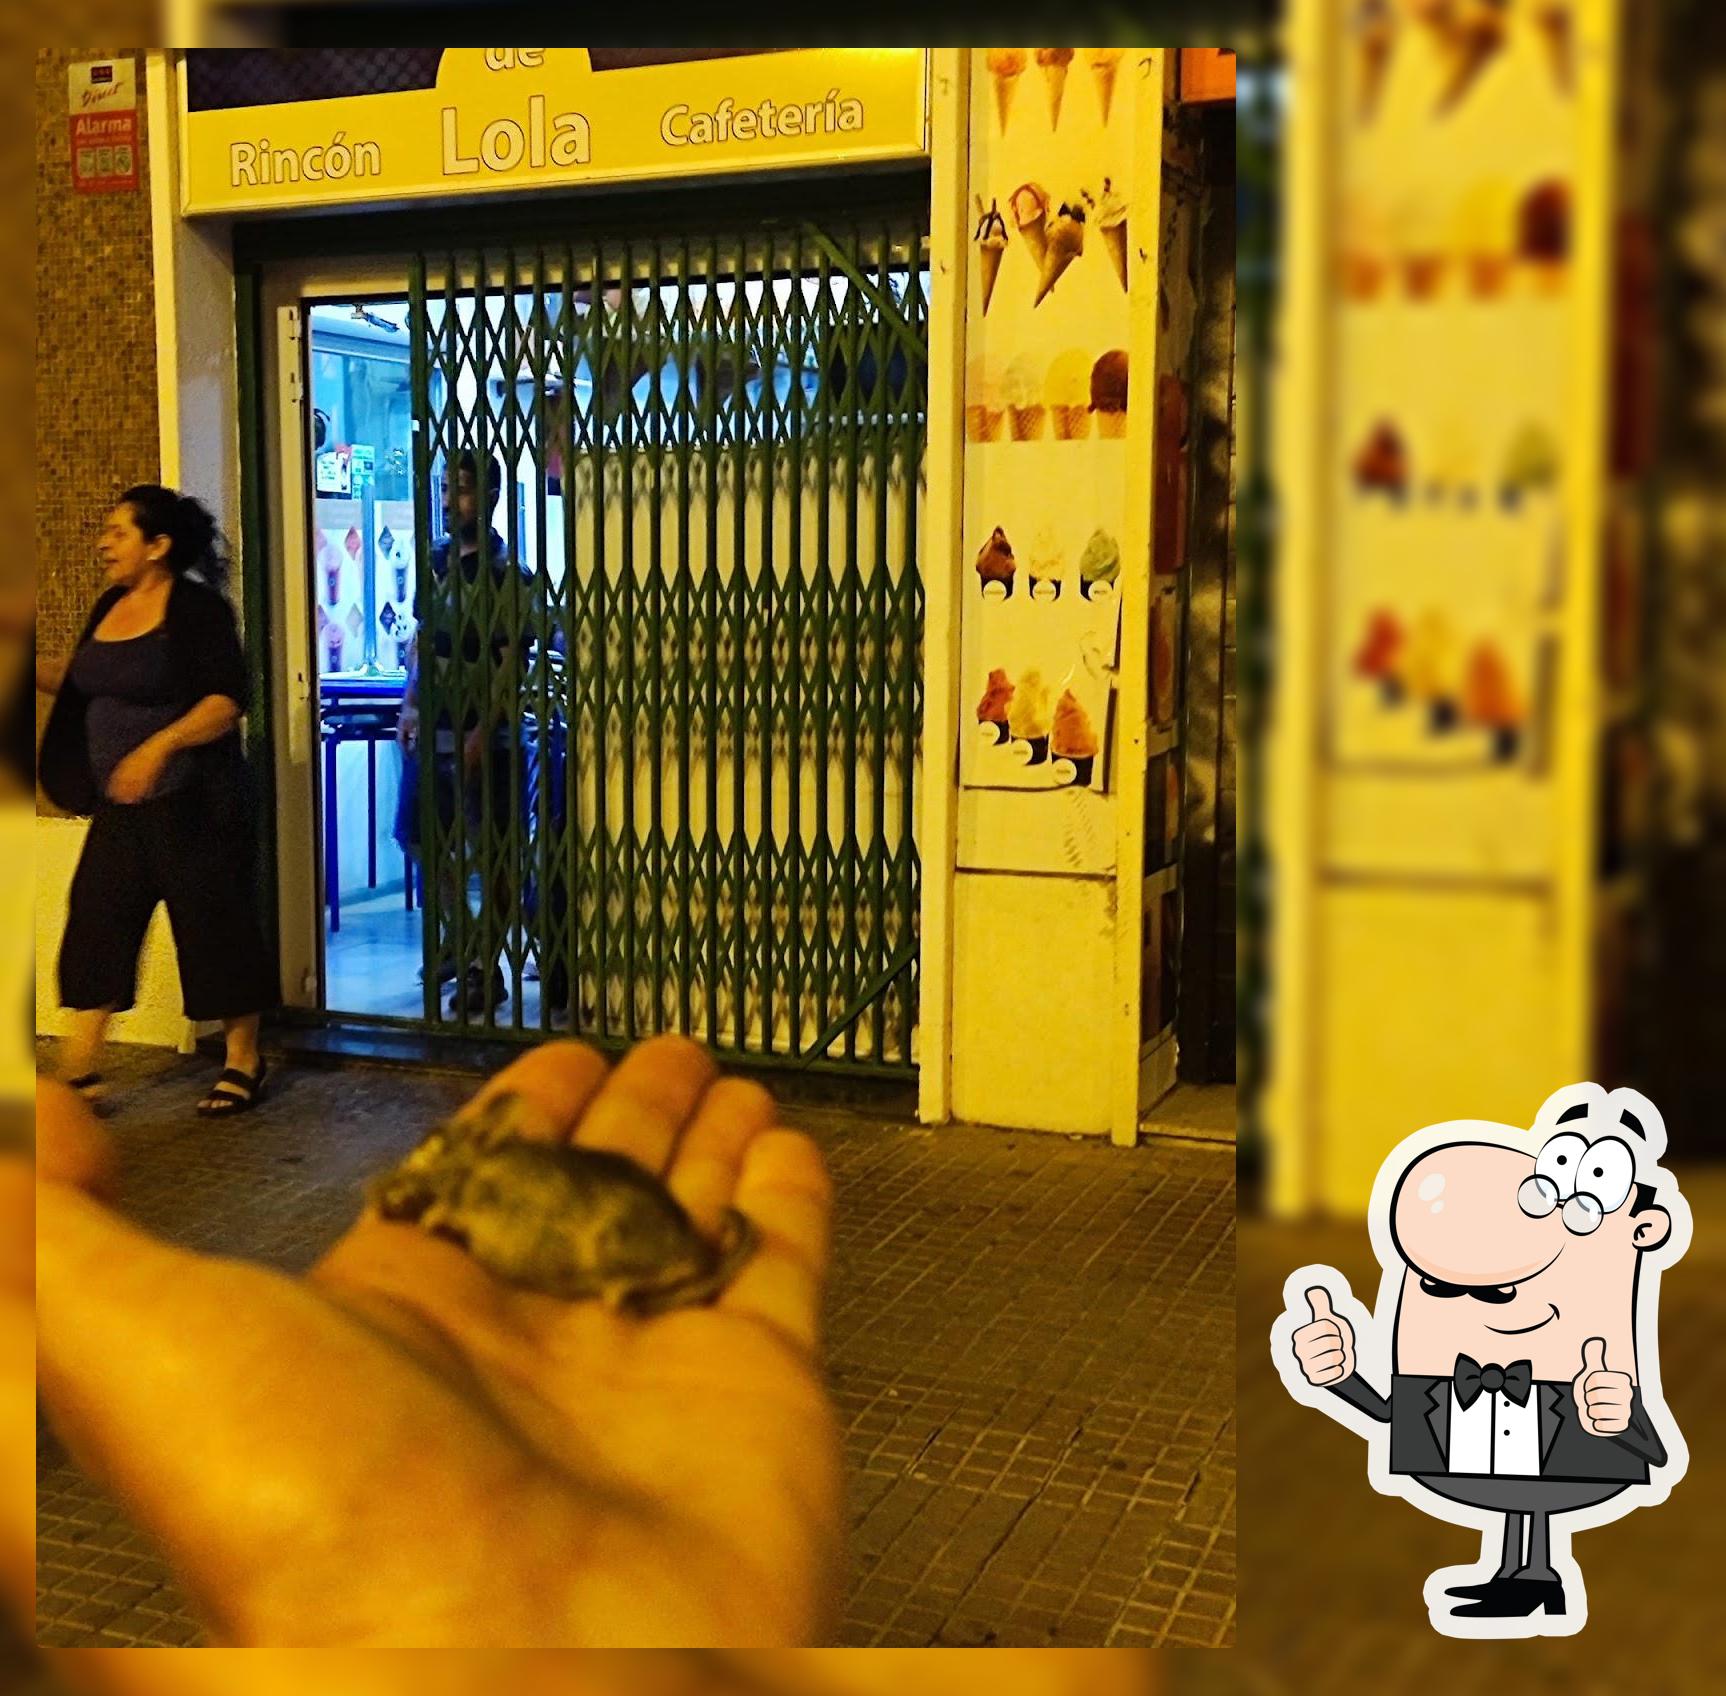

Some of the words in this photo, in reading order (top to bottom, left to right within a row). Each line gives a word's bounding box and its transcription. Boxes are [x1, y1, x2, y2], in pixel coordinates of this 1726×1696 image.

[76, 117, 132, 135] Alarma
[230, 131, 381, 187] Rincón
[441, 95, 591, 176] Lola
[660, 88, 864, 147] Cafetería
